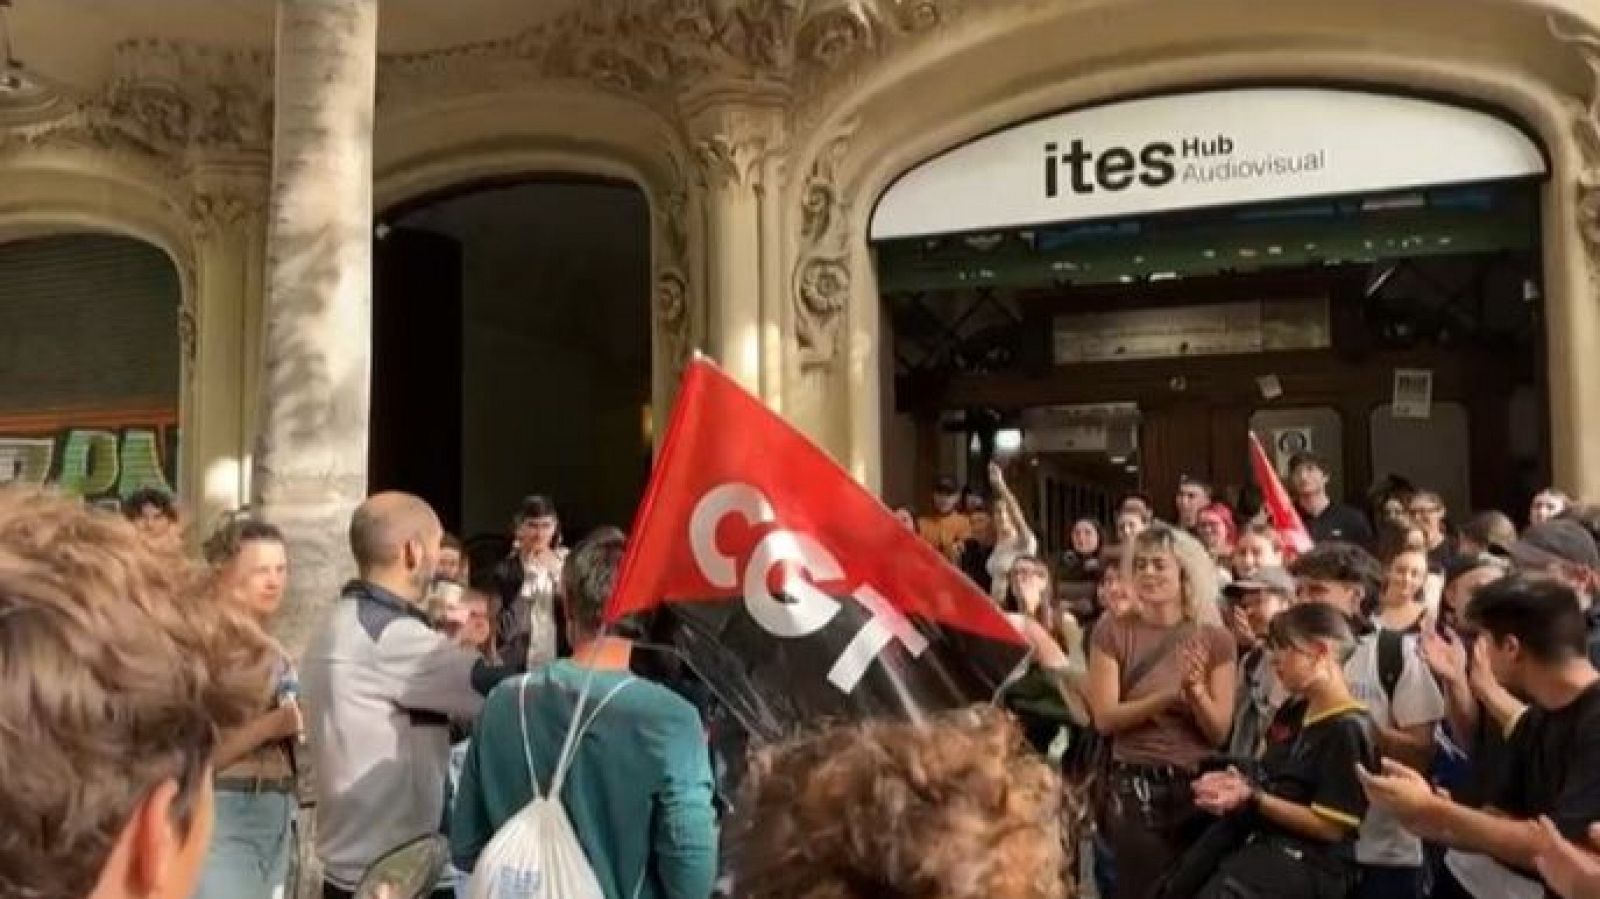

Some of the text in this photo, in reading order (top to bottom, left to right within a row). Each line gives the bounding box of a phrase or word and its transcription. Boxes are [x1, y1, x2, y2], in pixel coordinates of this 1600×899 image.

[1044, 139, 1176, 198] ites
[1182, 134, 1234, 157] Hub
[1182, 149, 1326, 183] Audiovisual
[689, 482, 929, 695] CGT
